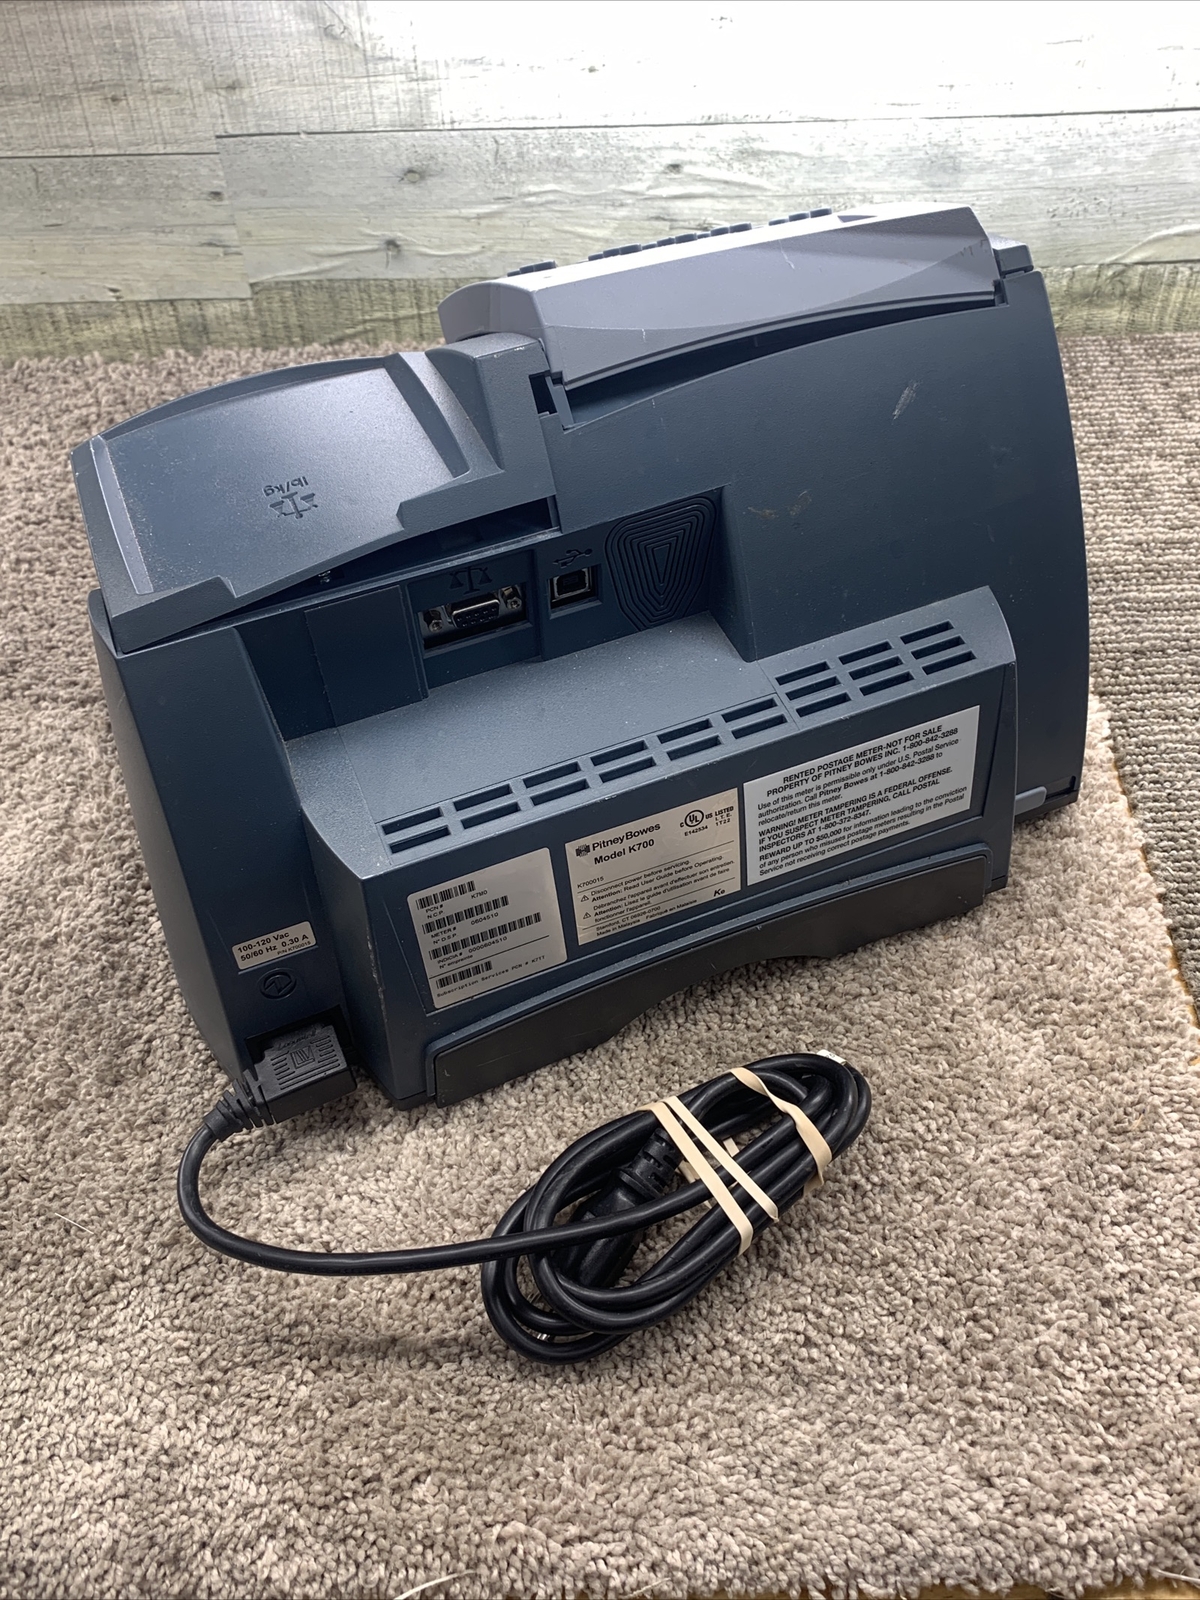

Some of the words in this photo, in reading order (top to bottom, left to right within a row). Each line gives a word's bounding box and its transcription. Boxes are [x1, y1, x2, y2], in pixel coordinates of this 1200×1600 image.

[767, 777, 809, 797] PROPERTY
[812, 773, 822, 782] OF
[824, 763, 852, 778] PITNEY
[854, 753, 883, 768] BOWES
[885, 747, 900, 758] INC.
[903, 728, 958, 752] 1-800-842-3288
[784, 767, 815, 784] RENTED
[818, 754, 854, 772] POSTAGE
[856, 738, 902, 760] METER-NOT
[904, 732, 920, 744] FOR
[922, 725, 942, 738] SALE
[758, 800, 771, 811] Use
[773, 797, 779, 806] of
[781, 793, 793, 804] this
[795, 786, 814, 799] meter
[816, 783, 821, 792] is
[823, 770, 860, 790] permissible
[862, 765, 876, 776] only
[877, 758, 896, 771] under
[898, 753, 911, 764] U.S.
[913, 746, 934, 759] Postal
[935, 737, 959, 752] Service
[758, 798, 802, 819] authorization.
[805, 793, 817, 804] Call
[819, 785, 842, 799] Pitney
[844, 776, 868, 791] Bowes
[870, 773, 878, 782] at
[880, 754, 935, 779] 1-800-842-3288
[936, 751, 943, 760] to
[715, 806, 734, 816] LISTED
[759, 819, 796, 837] WARNING!
[798, 810, 823, 824] METER
[825, 795, 867, 815] TAMPERING
[884, 778, 917, 795] FEDERAL
[918, 766, 952, 783] OFFENSE.
[759, 804, 807, 826] relocate/return
[808, 800, 820, 810] this
[822, 793, 842, 805] meter.
[768, 831, 783, 842] YOU
[785, 819, 818, 836] SUSPECT
[820, 810, 845, 824] METER
[847, 794, 891, 815] TAMPERING,
[893, 788, 911, 800] CALL
[913, 778, 940, 793] POSTAL
[759, 831, 805, 852] INSPECTORS
[807, 828, 816, 836] AT
[819, 809, 871, 832] 1-800-372-8347.
[760, 845, 791, 862] REWARD
[793, 841, 803, 850] UP
[805, 837, 814, 846] TO
[816, 828, 842, 842] $50,000
[843, 824, 852, 833] for
[854, 812, 889, 829] information
[891, 803, 914, 817] leading
[923, 797, 934, 806] the
[935, 785, 967, 802] conviction
[768, 857, 779, 867] any
[781, 849, 803, 862] person
[804, 844, 818, 854] who
[820, 834, 846, 849] misuses
[847, 825, 873, 839] postage
[874, 817, 896, 830] meters
[897, 807, 924, 822] resulting
[933, 801, 943, 810] the
[945, 794, 964, 806] Postal
[594, 848, 626, 865] Model
[629, 839, 654, 854] K700
[760, 863, 783, 876] Service
[785, 859, 795, 868] not
[797, 848, 826, 864] receiving
[827, 840, 849, 853] correct
[851, 831, 876, 845] postage
[878, 819, 910, 836] payments.
[591, 881, 623, 897] Disconnect
[625, 875, 643, 886] power
[644, 868, 662, 879] before
[624, 882, 639, 892] Read
[641, 877, 655, 886] User
[656, 871, 673, 881] Guide
[675, 864, 693, 875] before
[646, 890, 661, 900] guide
[694, 874, 708, 884] avant
[718, 867, 729, 875] faire
[654, 882, 668, 891] avant
[426, 905, 439, 914] PCN
[470, 911, 499, 926] 0604510
[238, 937, 272, 953] 100-120
[272, 931, 289, 941] Vac
[431, 928, 452, 939] METER
[597, 928, 611, 937] Made
[618, 918, 640, 929] Malaysia
[240, 949, 264, 961] 50/60
[265, 944, 278, 953] Hz
[281, 937, 300, 947] 0.30
[438, 953, 458, 964] INDICIA
[468, 935, 508, 954] 0000604510
[447, 954, 473, 966] empreinte
[437, 979, 479, 998] Subscription
[481, 968, 509, 982] Services
